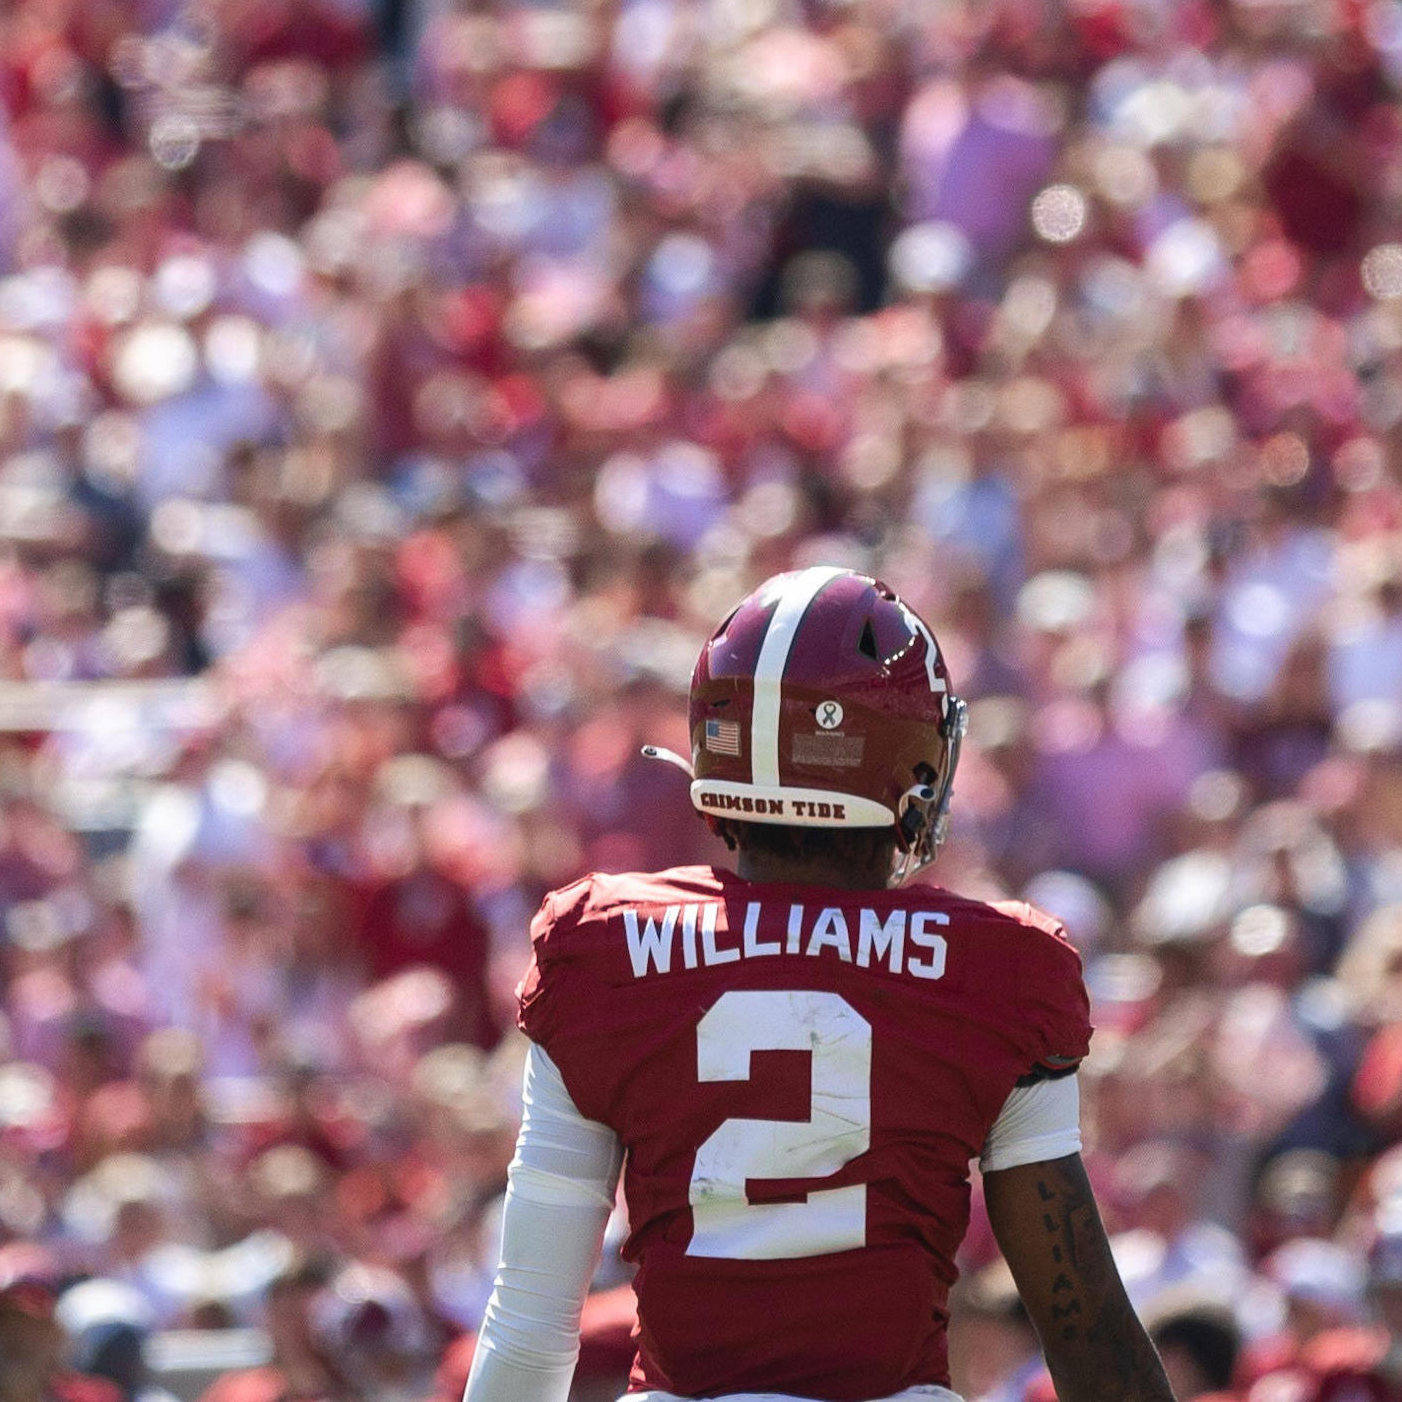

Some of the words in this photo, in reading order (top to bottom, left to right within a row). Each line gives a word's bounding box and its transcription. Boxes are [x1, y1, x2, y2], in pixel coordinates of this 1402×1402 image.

[700, 792, 784, 815] CRIMSON
[792, 801, 846, 820] TIDE
[623, 902, 950, 980] WILLIAMS
[685, 990, 872, 1260] 2
